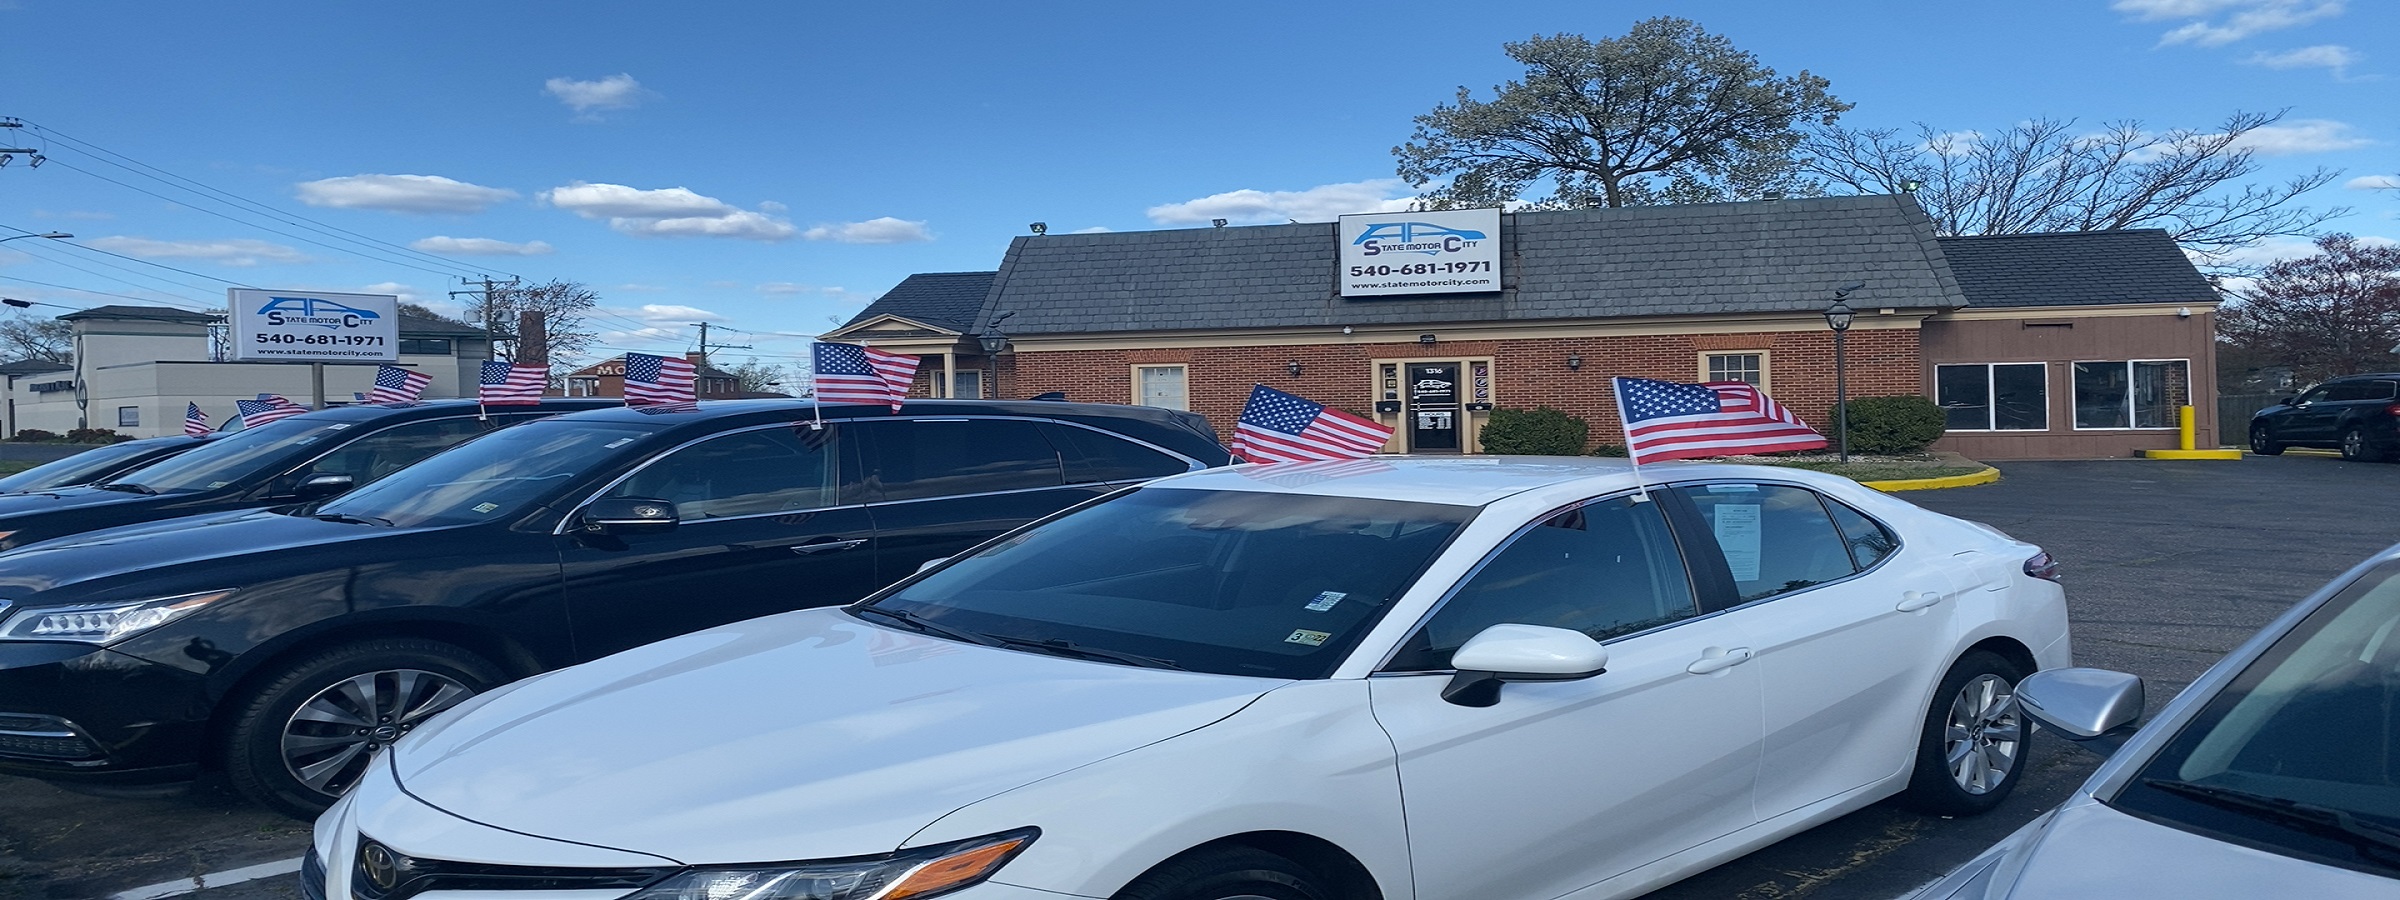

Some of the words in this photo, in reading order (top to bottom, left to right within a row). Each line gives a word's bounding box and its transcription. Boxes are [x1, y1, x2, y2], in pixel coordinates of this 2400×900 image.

[1364, 240, 1404, 256] STATE
[1406, 242, 1441, 250] MOTOR
[1443, 236, 1478, 252] CITY
[1350, 261, 1490, 277] 540-681-1971
[1351, 278, 1489, 289] www.statemotorcity.com
[268, 311, 307, 325] STATE
[343, 314, 373, 328] CITY
[256, 333, 384, 346] 540-681-1971
[257, 349, 383, 357] www.statemotorcity.com
